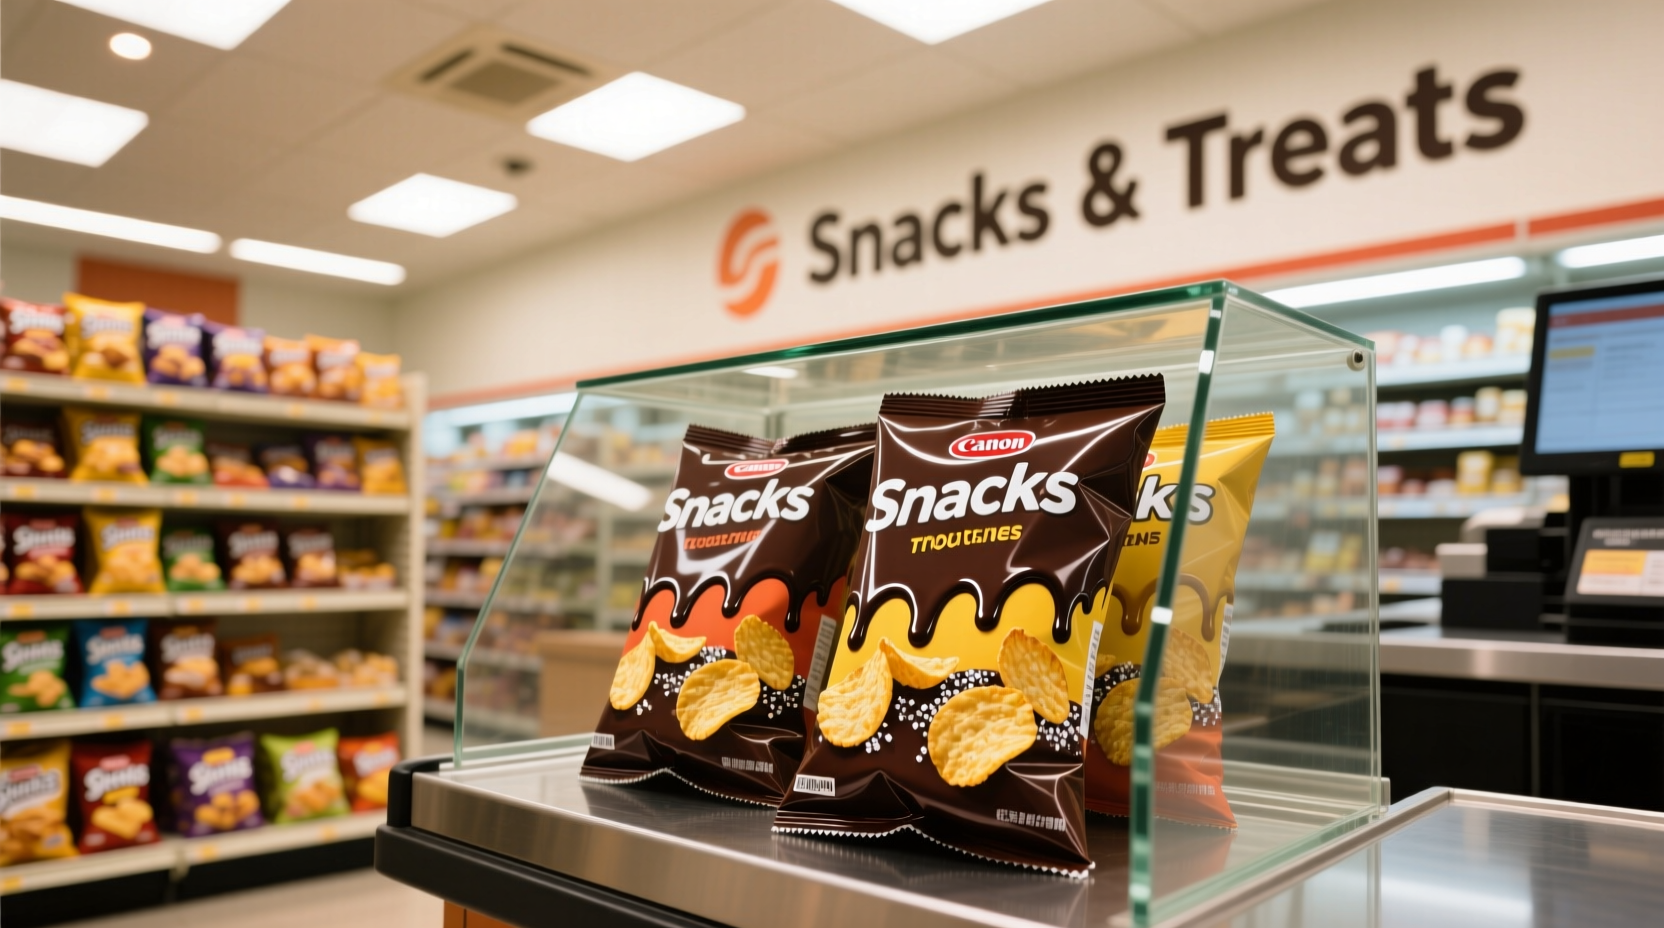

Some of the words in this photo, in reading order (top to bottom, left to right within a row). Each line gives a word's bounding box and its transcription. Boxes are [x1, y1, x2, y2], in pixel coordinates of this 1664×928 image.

[809, 172, 1050, 283] Snacks
[1082, 142, 1141, 228] &
[1166, 66, 1525, 209] Treats
[957, 437, 1025, 452] Canon
[657, 478, 815, 532] Snacks
[865, 462, 1079, 532] Snacks
